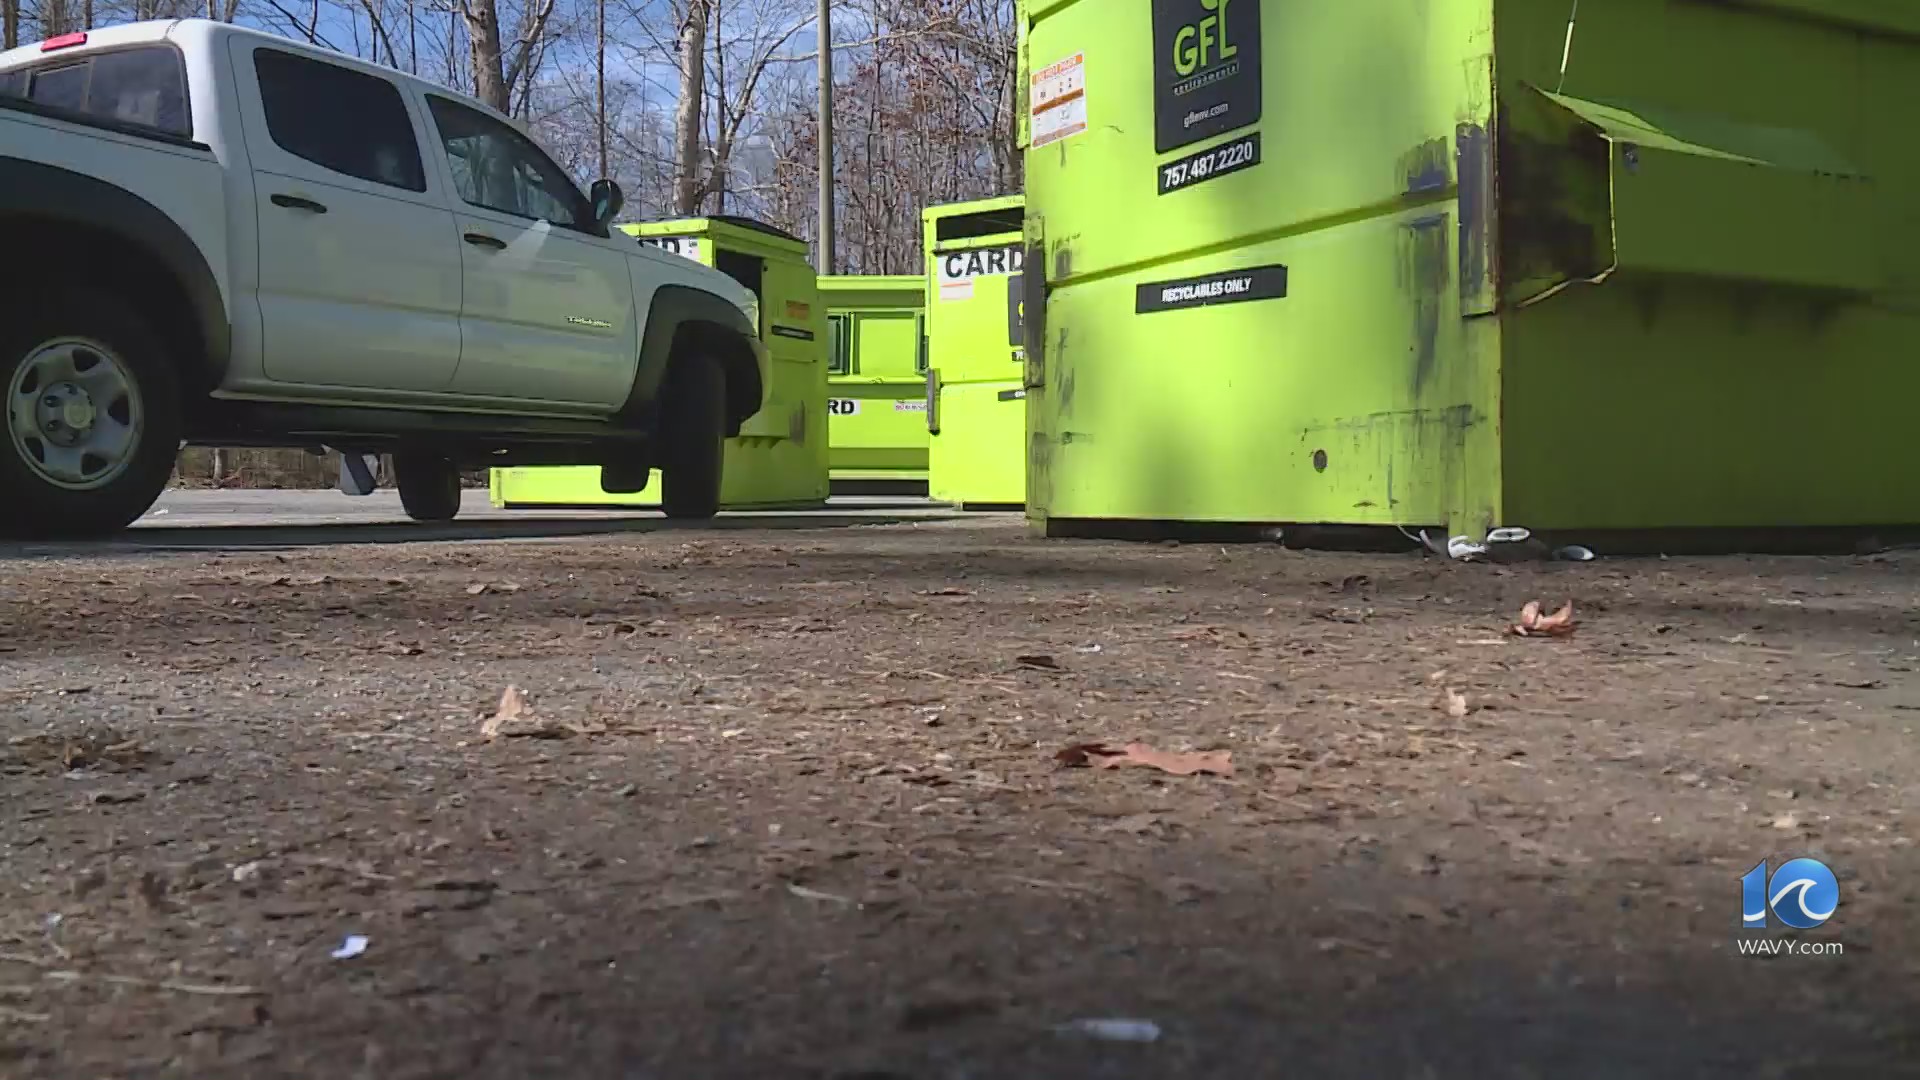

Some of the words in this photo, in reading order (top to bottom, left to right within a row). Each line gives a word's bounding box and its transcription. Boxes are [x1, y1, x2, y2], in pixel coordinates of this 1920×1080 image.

[1173, 6, 1237, 76] GFL
[1163, 141, 1253, 188] 757.487.2220
[945, 247, 1024, 278] CARD
[1162, 280, 1223, 302] RECYCLABLES
[1224, 277, 1252, 294] ONLY
